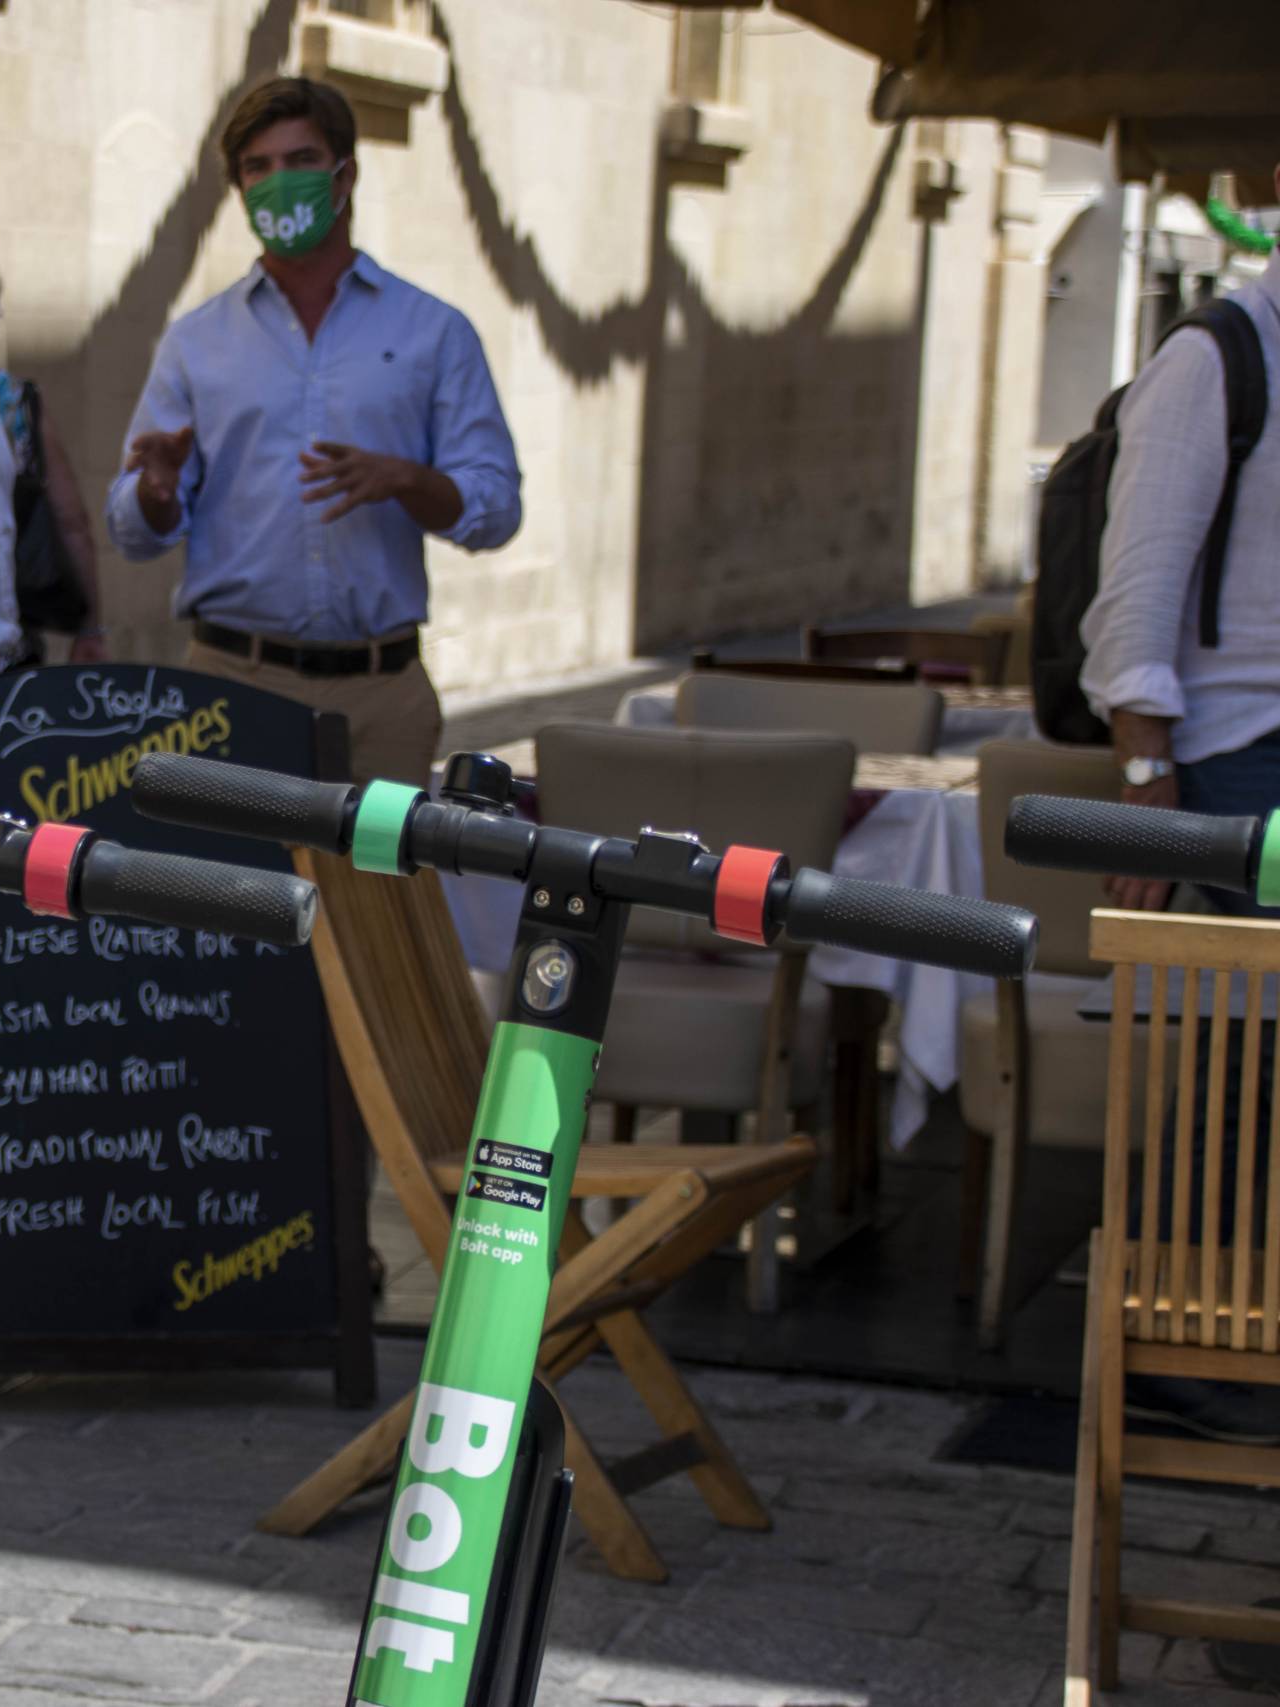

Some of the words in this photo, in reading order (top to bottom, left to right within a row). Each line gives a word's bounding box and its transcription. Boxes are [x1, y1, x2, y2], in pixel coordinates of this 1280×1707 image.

[88, 915, 184, 961] PLATTER
[491, 1152, 512, 1167] App
[514, 1157, 543, 1172] Store
[101, 1190, 186, 1240] LOCAL
[483, 1184, 519, 1202] Google
[520, 1191, 541, 1208] Play
[457, 1216, 501, 1238] Unlock
[505, 1228, 538, 1247] with
[172, 1210, 314, 1311] Schweppes
[460, 1237, 488, 1255] Bolt
[492, 1247, 523, 1265] app
[366, 1381, 517, 1673] Bolt
